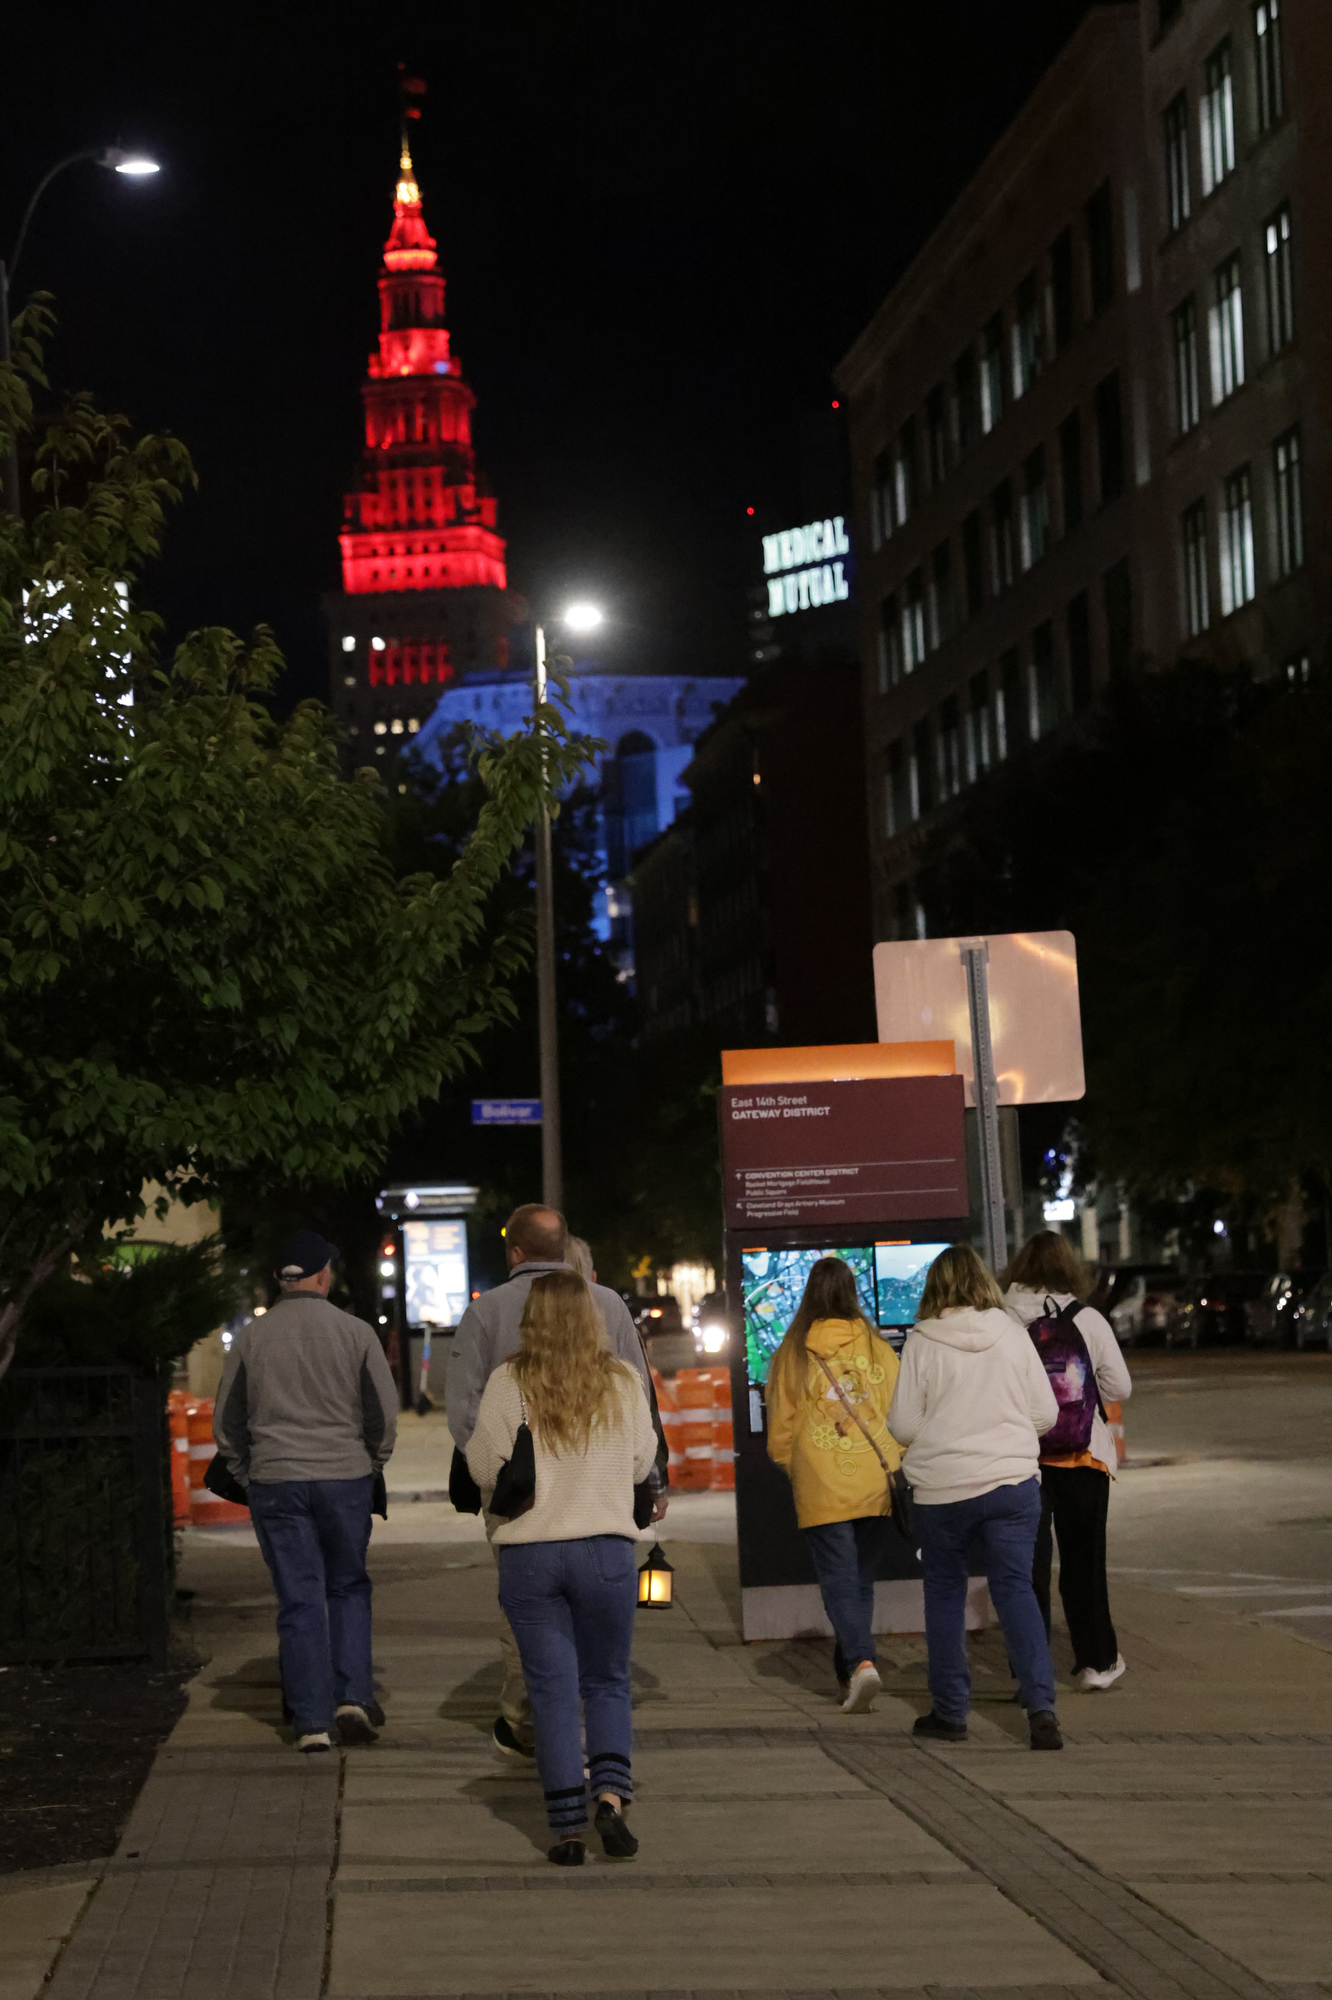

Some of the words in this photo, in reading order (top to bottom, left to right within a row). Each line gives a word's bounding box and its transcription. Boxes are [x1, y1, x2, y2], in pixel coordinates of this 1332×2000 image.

[762, 516, 849, 574] MEDICAL
[767, 561, 849, 617] MUTUAL
[731, 1097, 753, 1108] East
[756, 1096, 776, 1106] 14th
[777, 1095, 808, 1106] Street
[731, 1109, 781, 1120] GATEWAY
[782, 1106, 831, 1118] DISTRICT
[745, 1171, 793, 1180] CONVENTION
[794, 1169, 825, 1178] CENTER
[825, 1167, 859, 1176] DISTRICT
